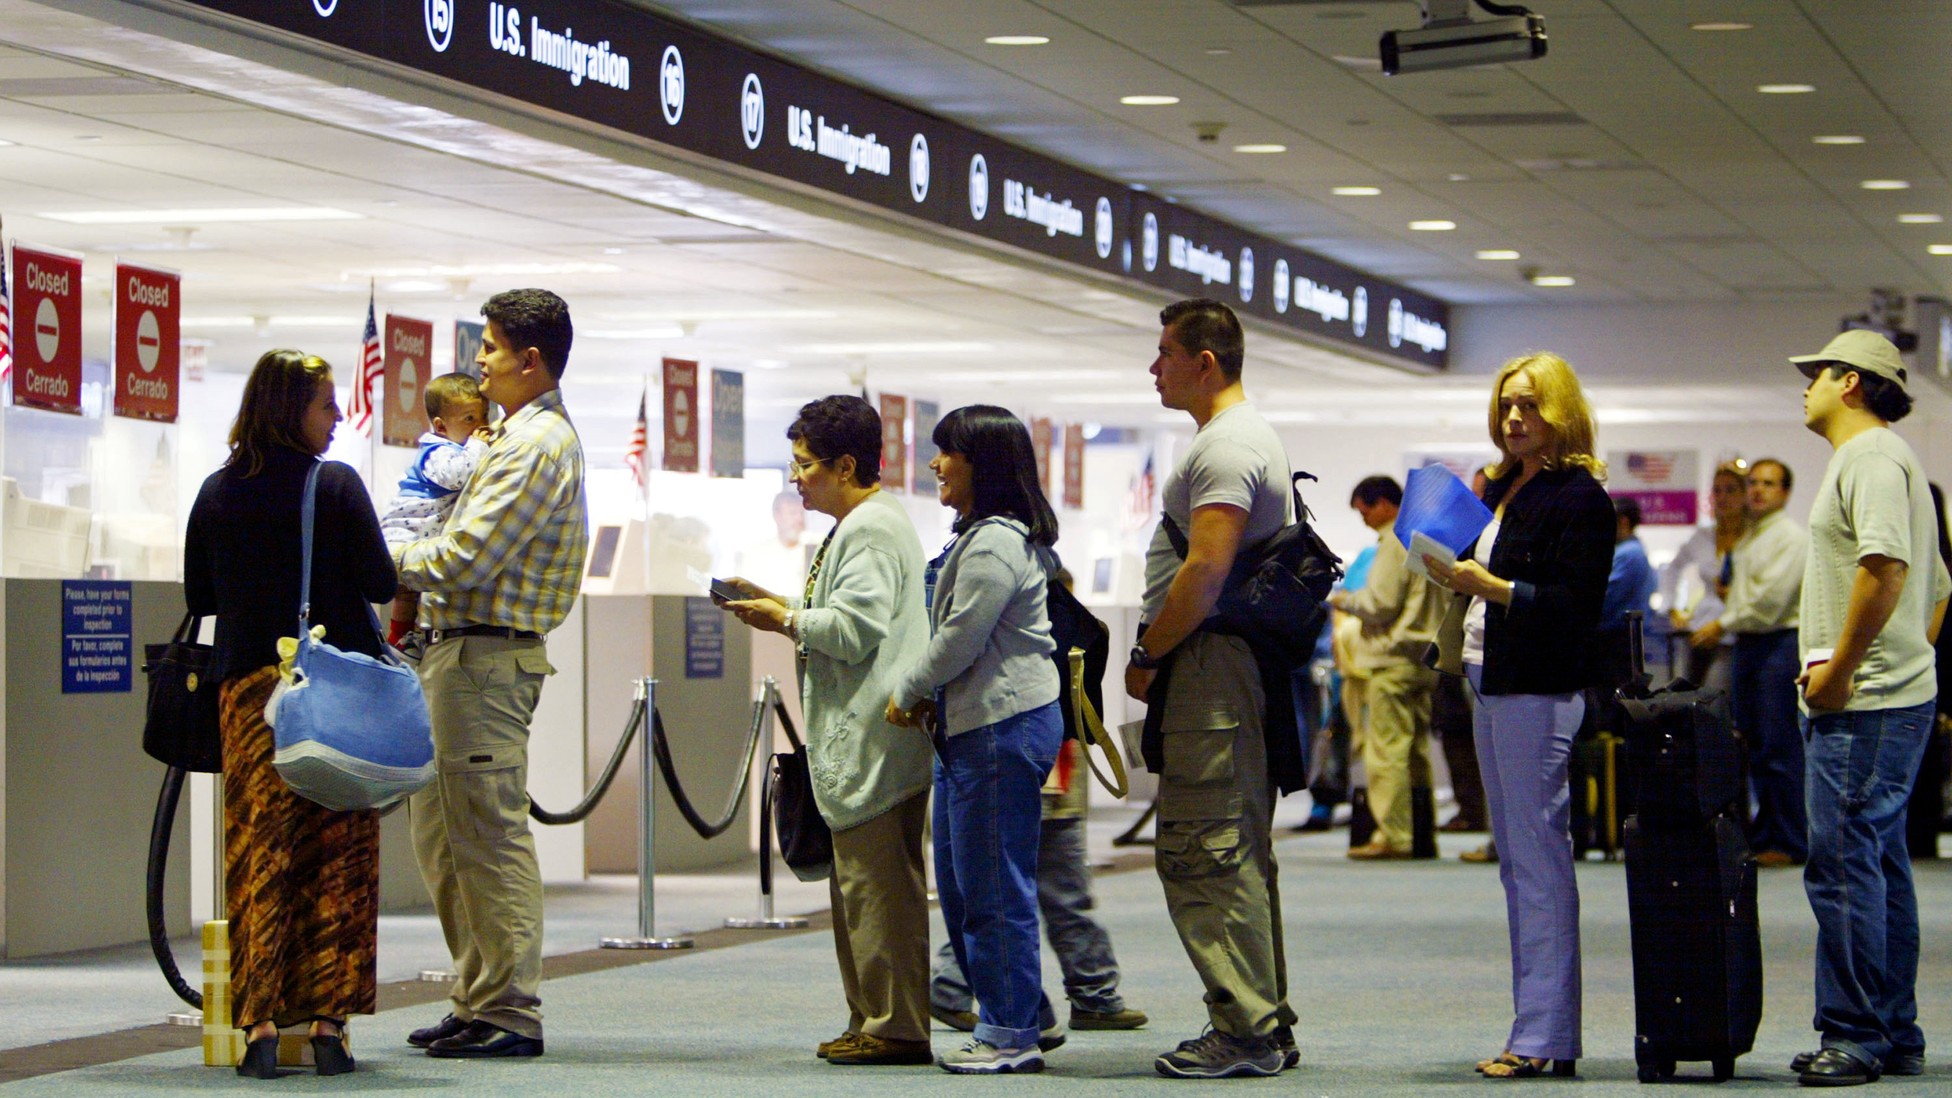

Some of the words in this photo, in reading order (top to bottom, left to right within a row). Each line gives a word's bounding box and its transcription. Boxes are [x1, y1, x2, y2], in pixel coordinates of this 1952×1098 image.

[489, 1, 526, 57] U.S.
[531, 16, 630, 91] Immigration
[664, 62, 680, 108] 16
[745, 91, 761, 133] 17
[787, 105, 816, 153] U.S.
[817, 115, 891, 177] Immigration
[1026, 186, 1084, 237] Immigration
[26, 262, 69, 296] Closed
[128, 275, 169, 308] Closed
[393, 327, 425, 357] Closed
[26, 367, 69, 398] Cerrado
[127, 372, 168, 400] Cerrado
